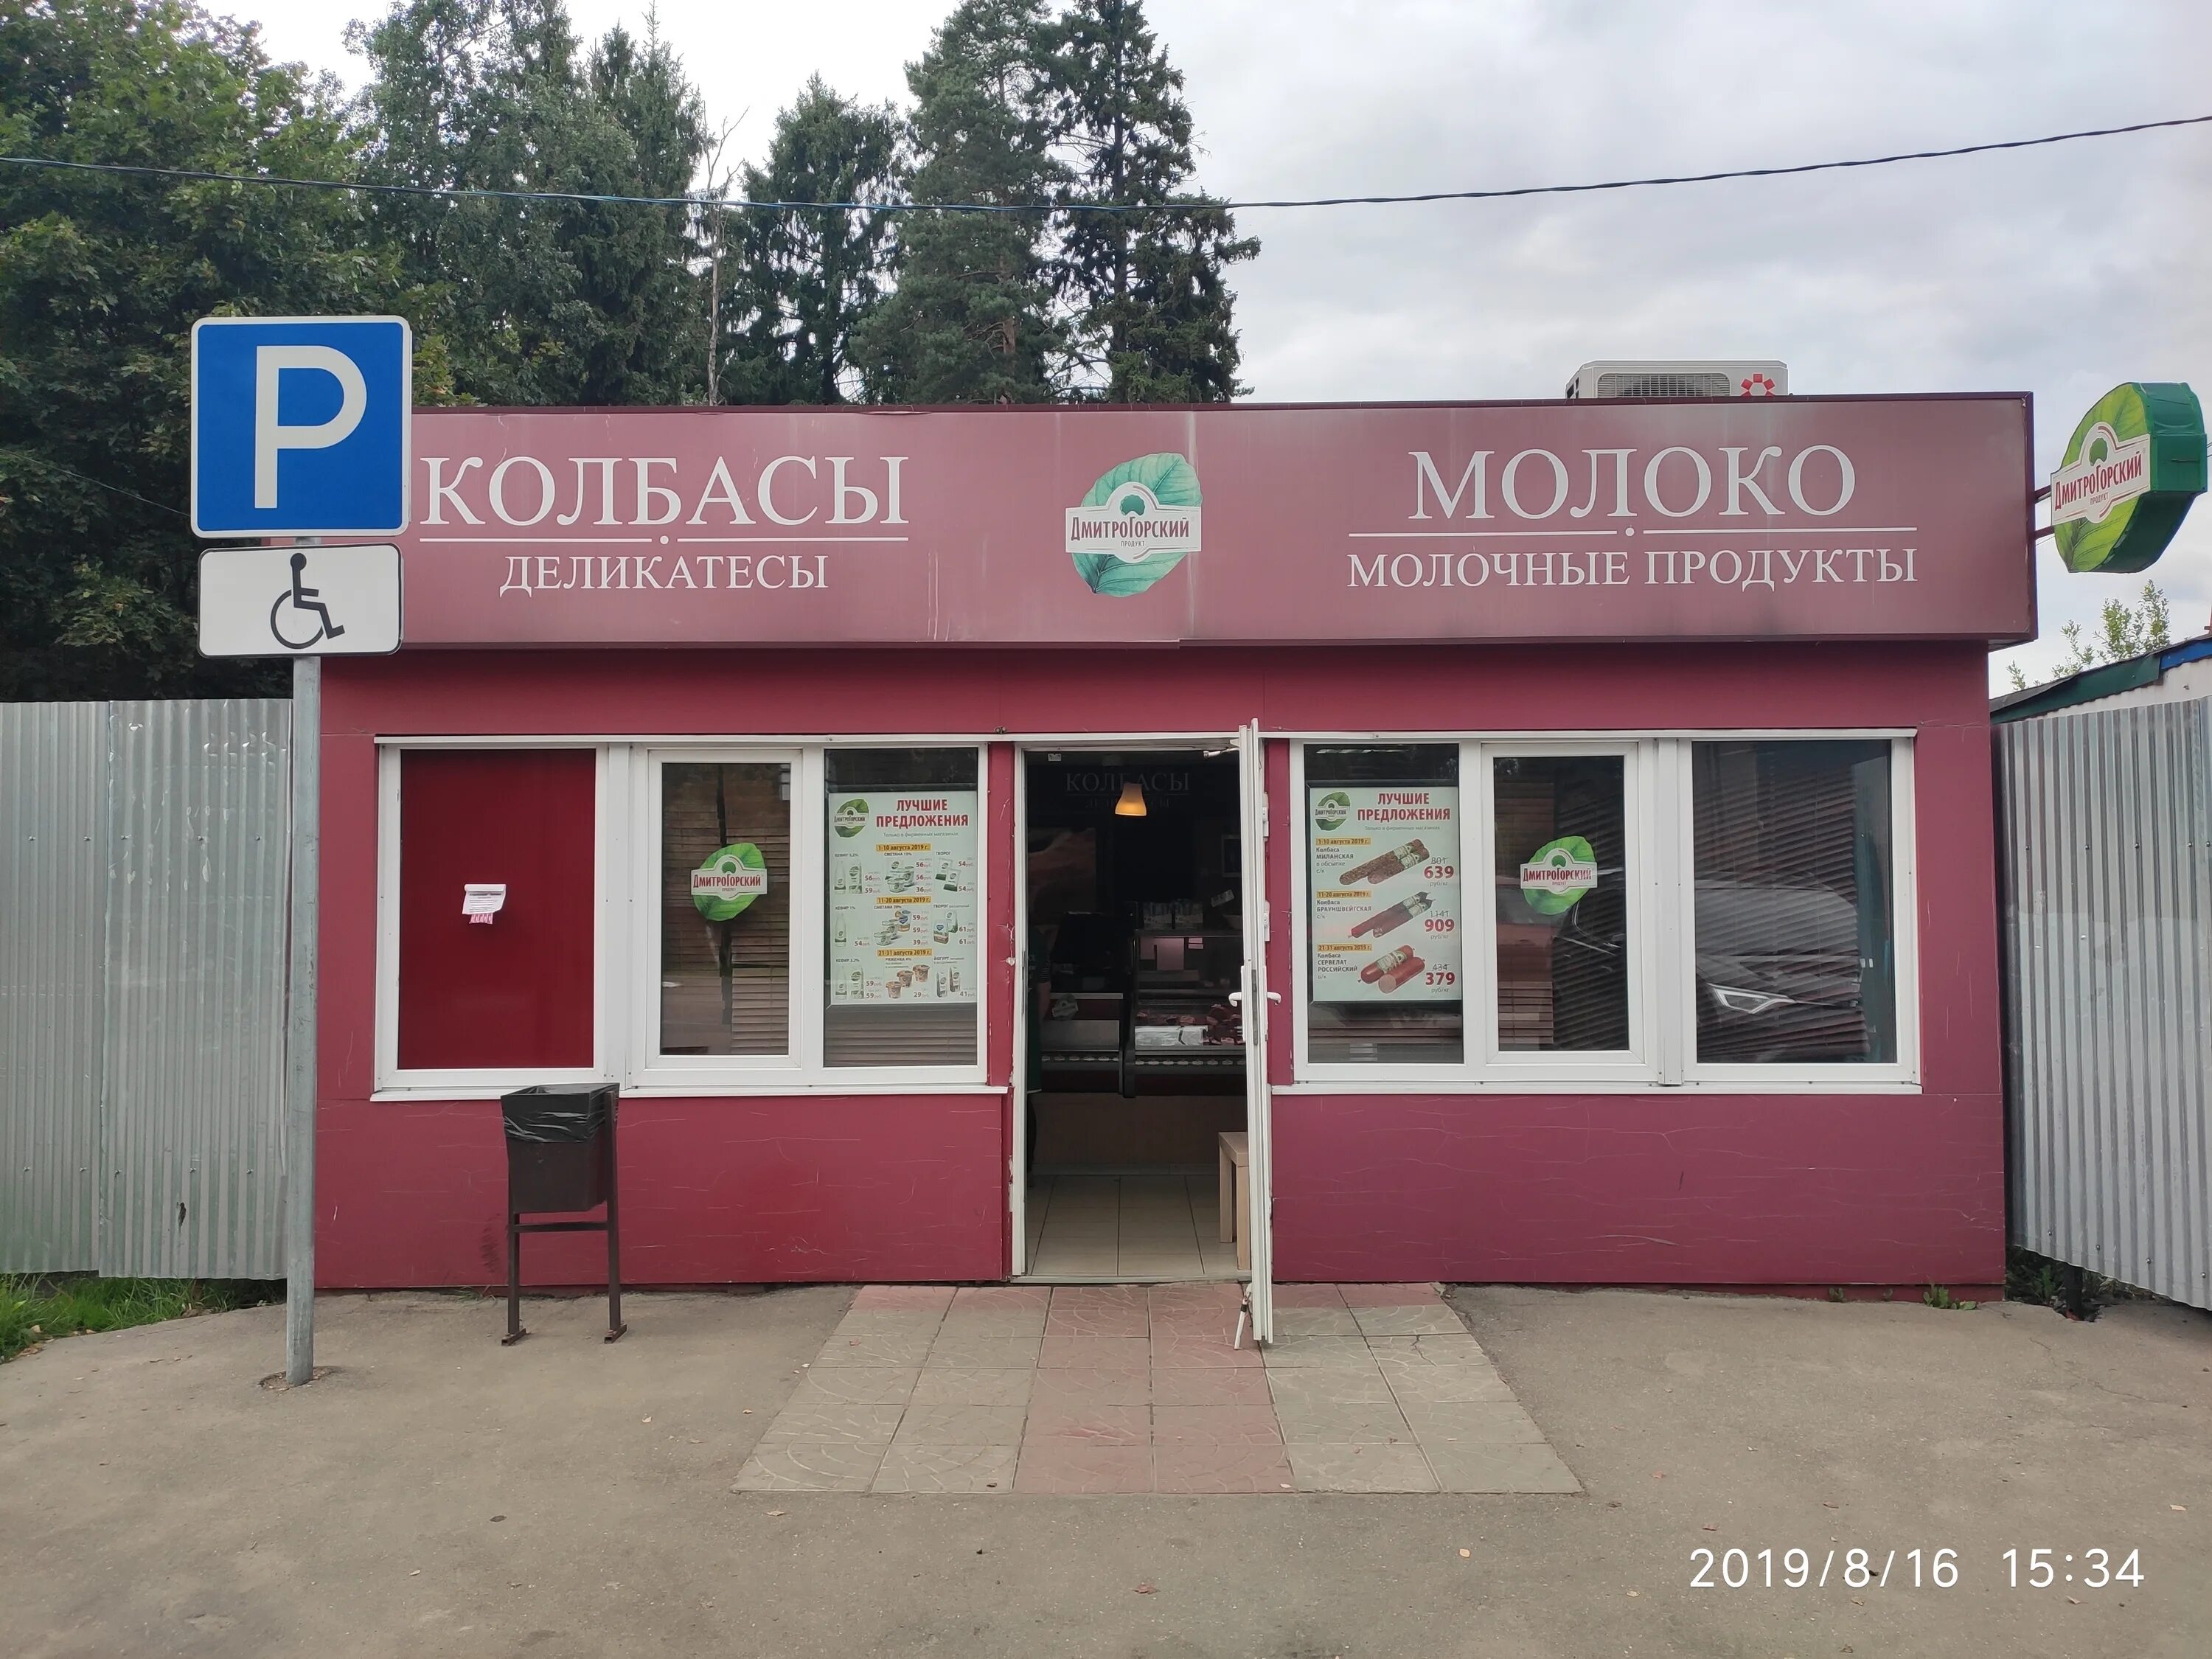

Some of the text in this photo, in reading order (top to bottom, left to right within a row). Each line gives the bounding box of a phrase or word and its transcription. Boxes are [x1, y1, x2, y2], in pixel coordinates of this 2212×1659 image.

[254, 346, 367, 508] P
[1408, 445, 1855, 519] МОЛОКО
[420, 456, 908, 526] КОЛБАСЫ
[500, 554, 828, 597] ДЕЛИКАТЕСЫ
[1346, 548, 1917, 591] МОЛОЧНЫЕ ПРОДУКТЫ
[897, 799, 947, 812] ЛУЧШИЕ
[1378, 793, 1429, 805] ЛУЧШИЕ
[876, 814, 969, 829] ПРЕДЛОЖЕНИЯ
[1357, 808, 1450, 822] ПРЕДЛОЖЕНИЯ
[1424, 866, 1454, 879] 639
[1425, 919, 1455, 932] 909
[1425, 972, 1455, 986] 379
